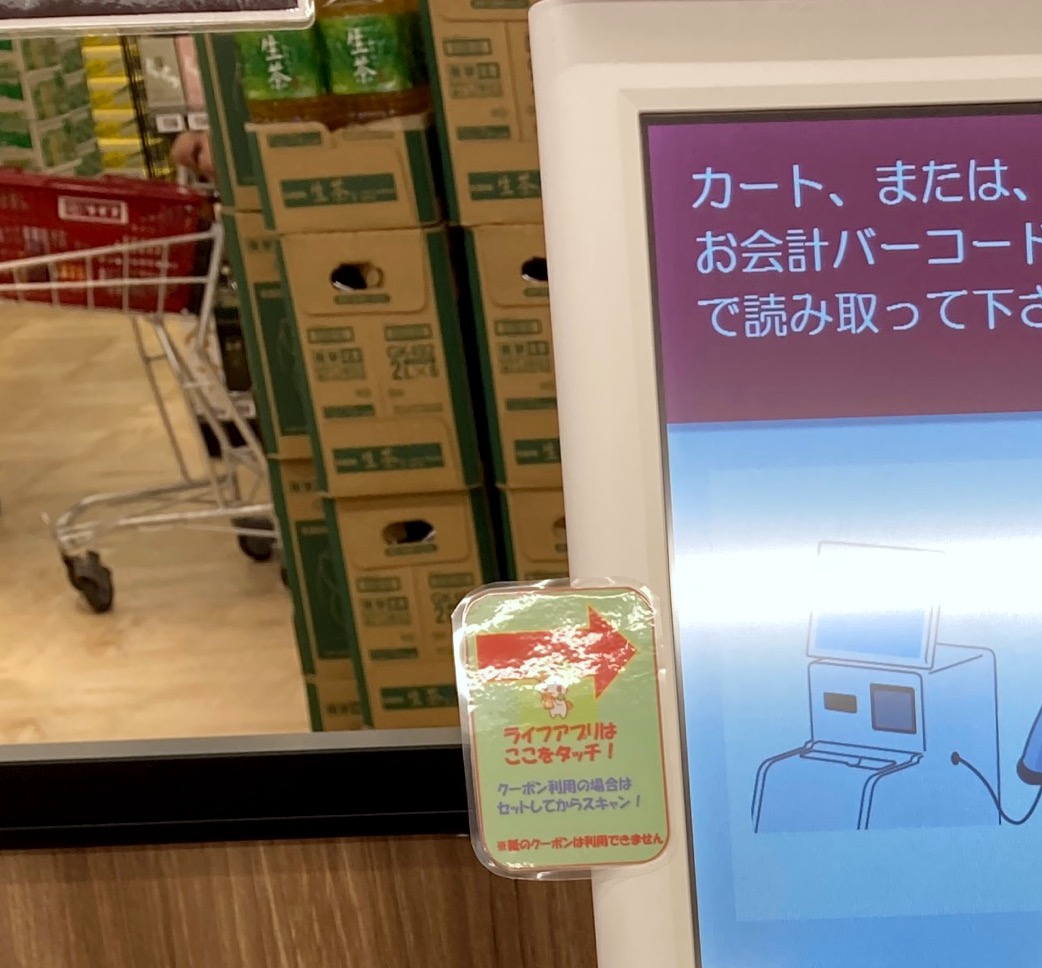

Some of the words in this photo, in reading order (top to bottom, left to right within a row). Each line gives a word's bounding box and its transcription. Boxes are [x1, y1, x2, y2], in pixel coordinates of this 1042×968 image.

[503, 722, 618, 745] ライフアプリは
[497, 776, 633, 797] クーポン利用の場合は
